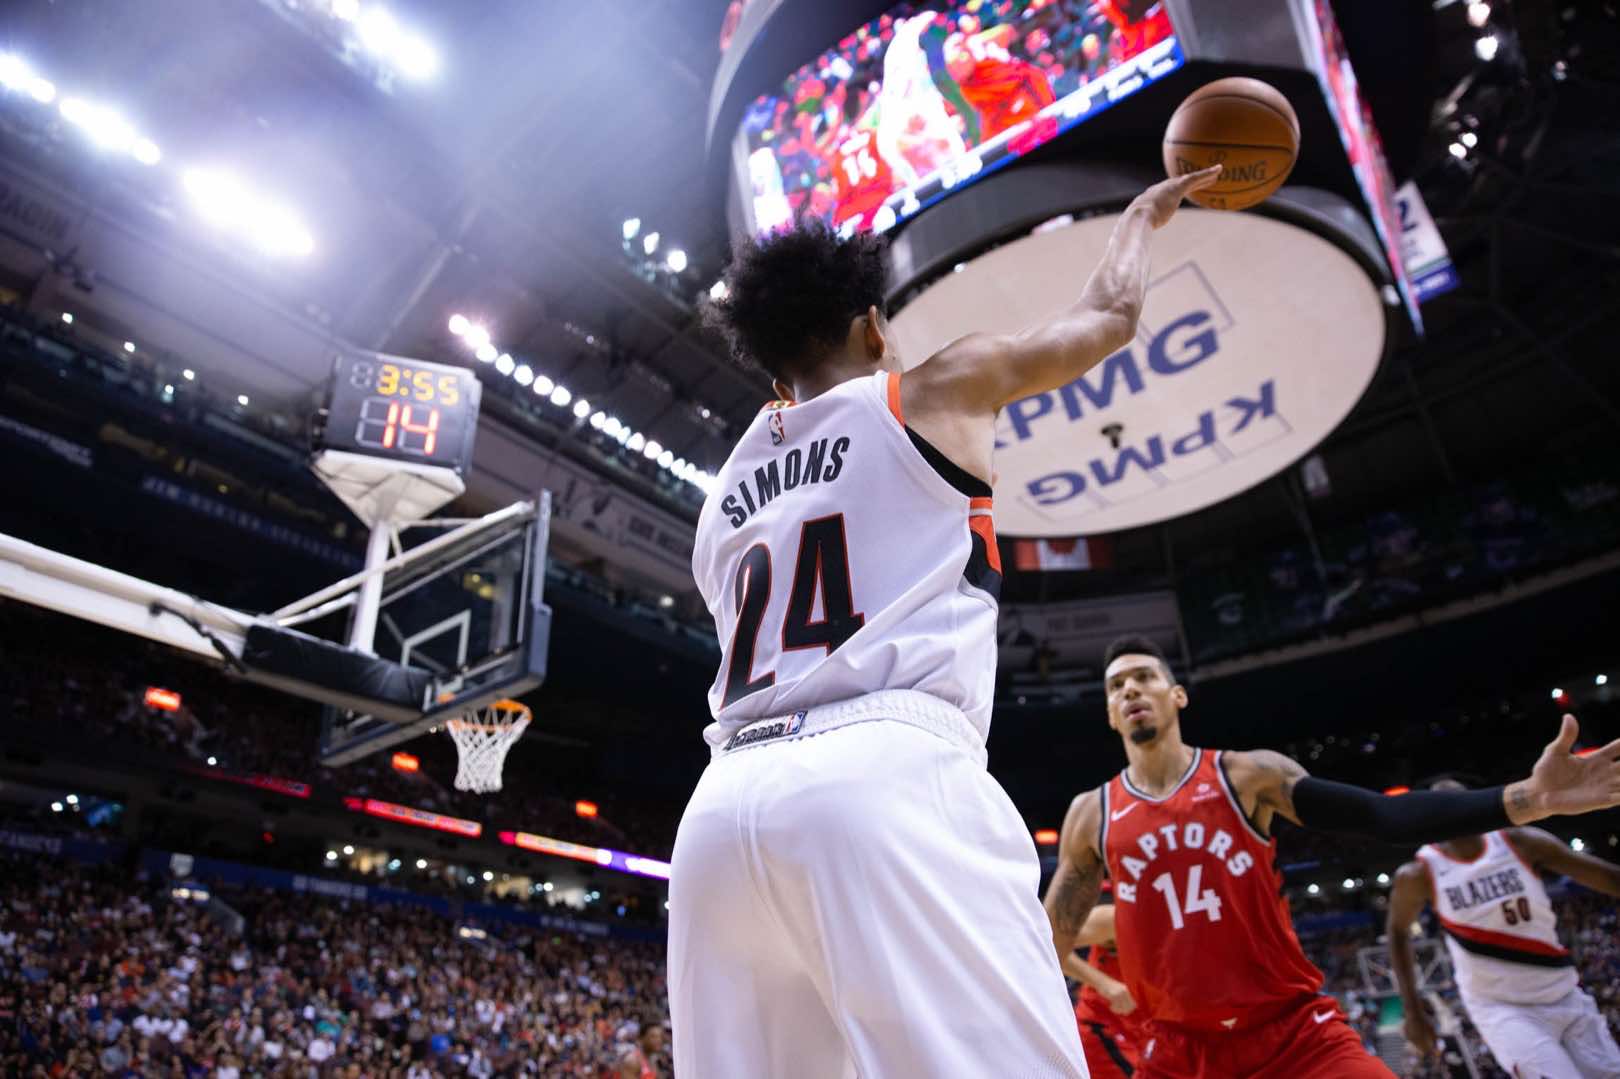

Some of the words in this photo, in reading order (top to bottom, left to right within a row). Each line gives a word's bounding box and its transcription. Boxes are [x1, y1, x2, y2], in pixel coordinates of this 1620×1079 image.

[376, 363, 461, 407] 3:55
[993, 309, 1219, 450] PMG
[382, 400, 440, 456] 14
[1025, 379, 1275, 507] KPMG
[720, 435, 851, 530] SIMONS
[719, 511, 866, 712] 24
[1117, 821, 1255, 904] RAPTORS
[1152, 863, 1222, 930] 14
[1444, 868, 1526, 911] BLAZERS
[1500, 897, 1531, 926] 50
